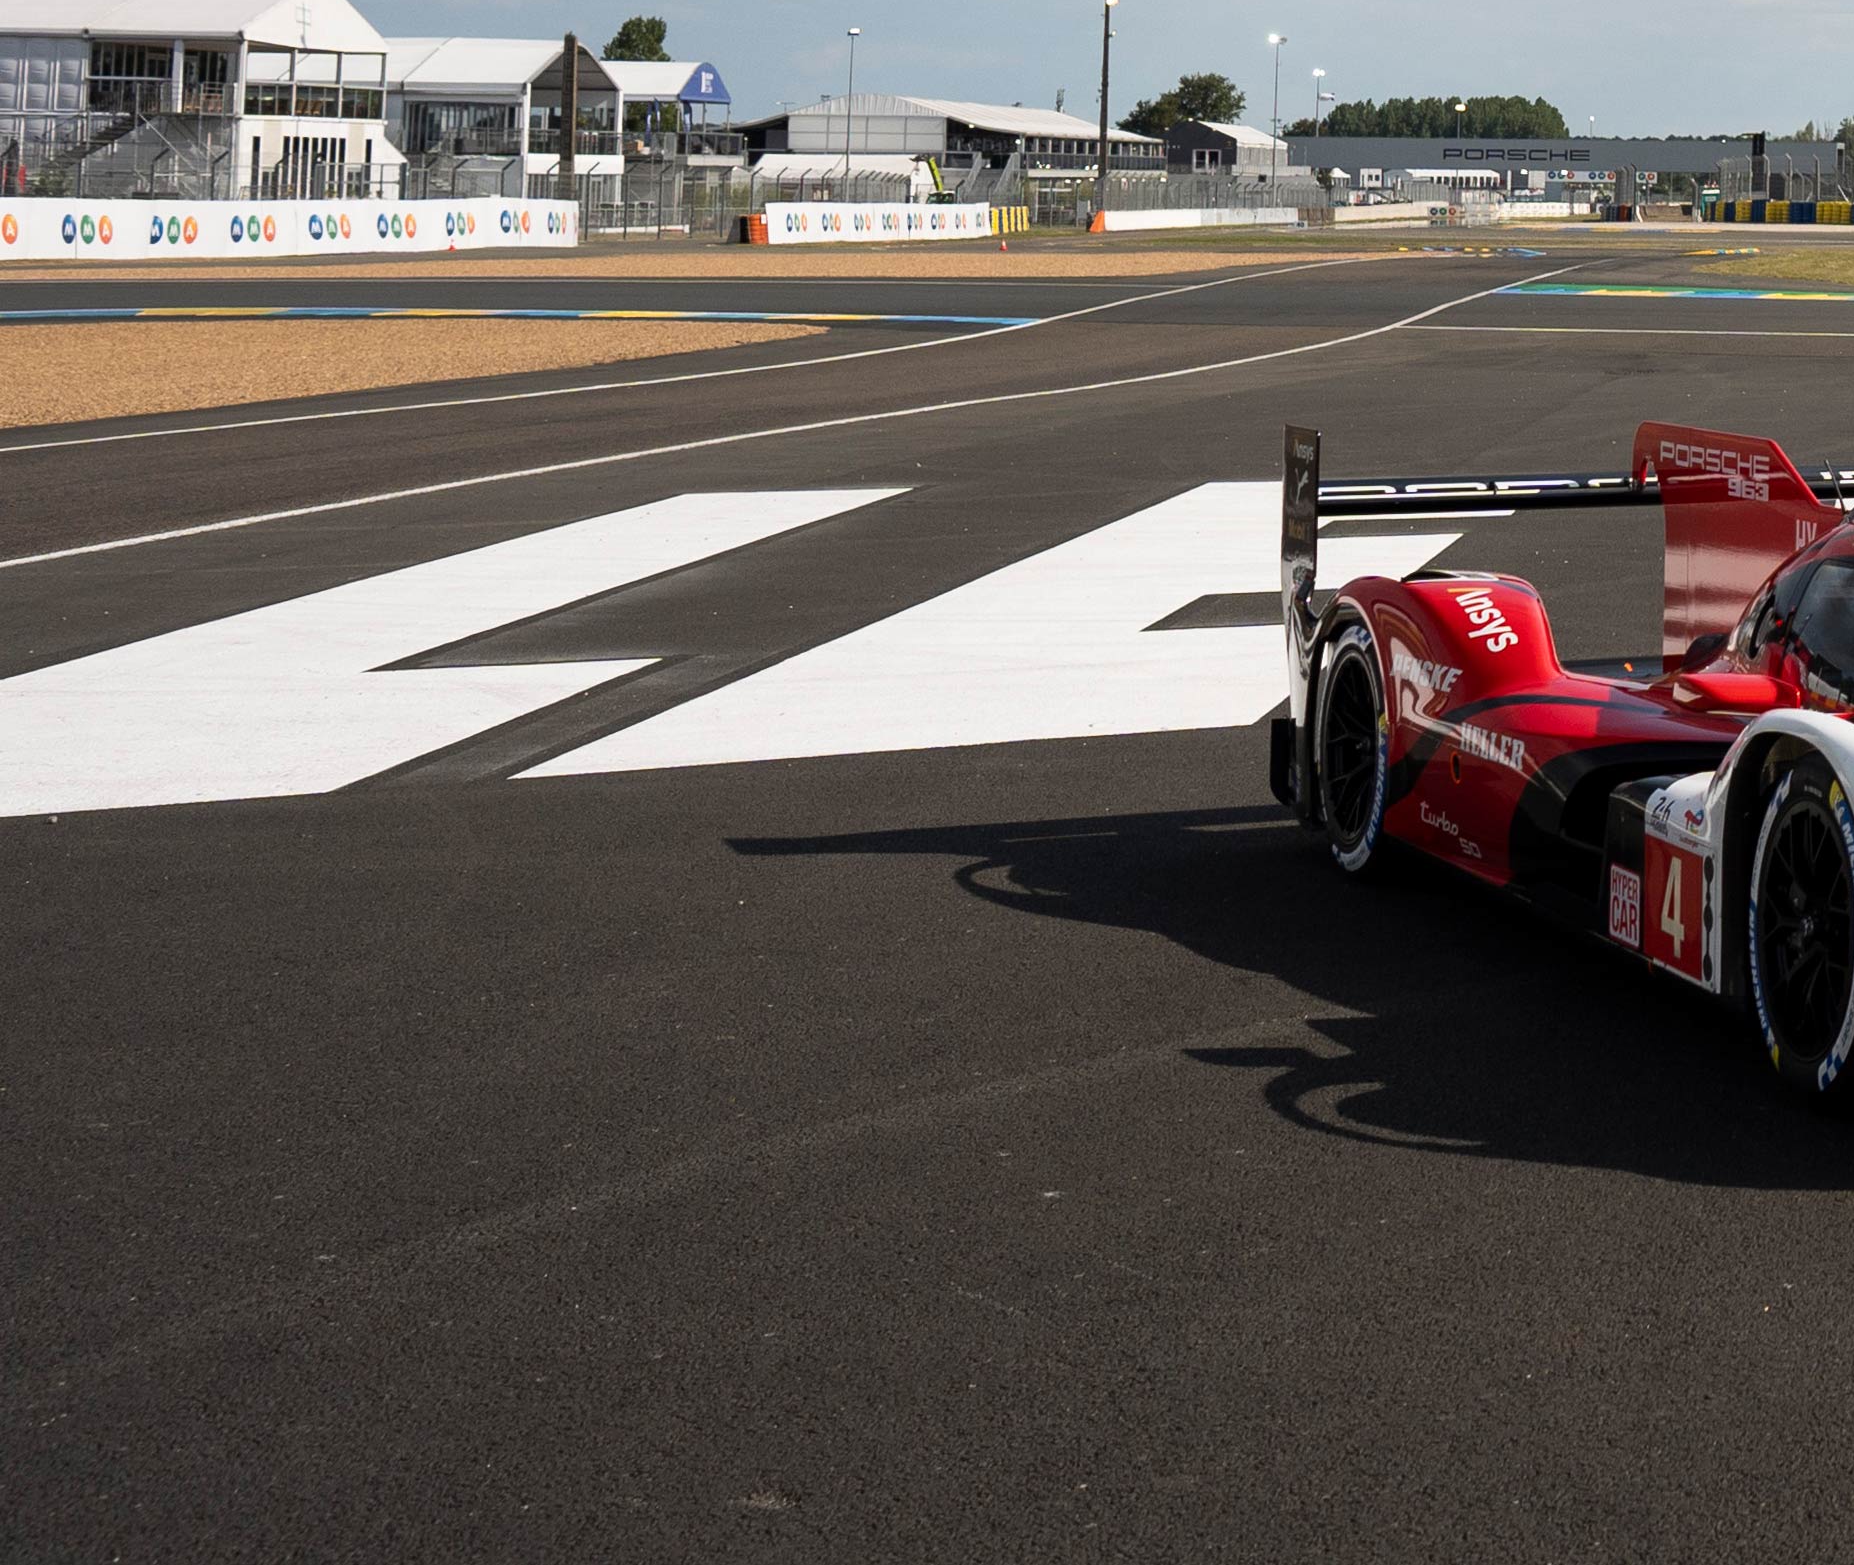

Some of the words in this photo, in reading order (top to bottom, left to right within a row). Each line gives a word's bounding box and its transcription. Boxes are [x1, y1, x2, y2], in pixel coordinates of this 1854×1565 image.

[1443, 148, 1590, 161] PORSCHE
[1660, 440, 1770, 480] PORSCHE
[1728, 478, 1770, 502] 963
[1446, 587, 1519, 654] Ansys
[1390, 653, 1463, 693] PENSKE
[1460, 722, 1526, 771] HELLER
[1420, 800, 1459, 837] turbo
[1611, 867, 1639, 901] HYPER
[1610, 896, 1638, 941] CAR
[1661, 856, 1685, 959] 4
